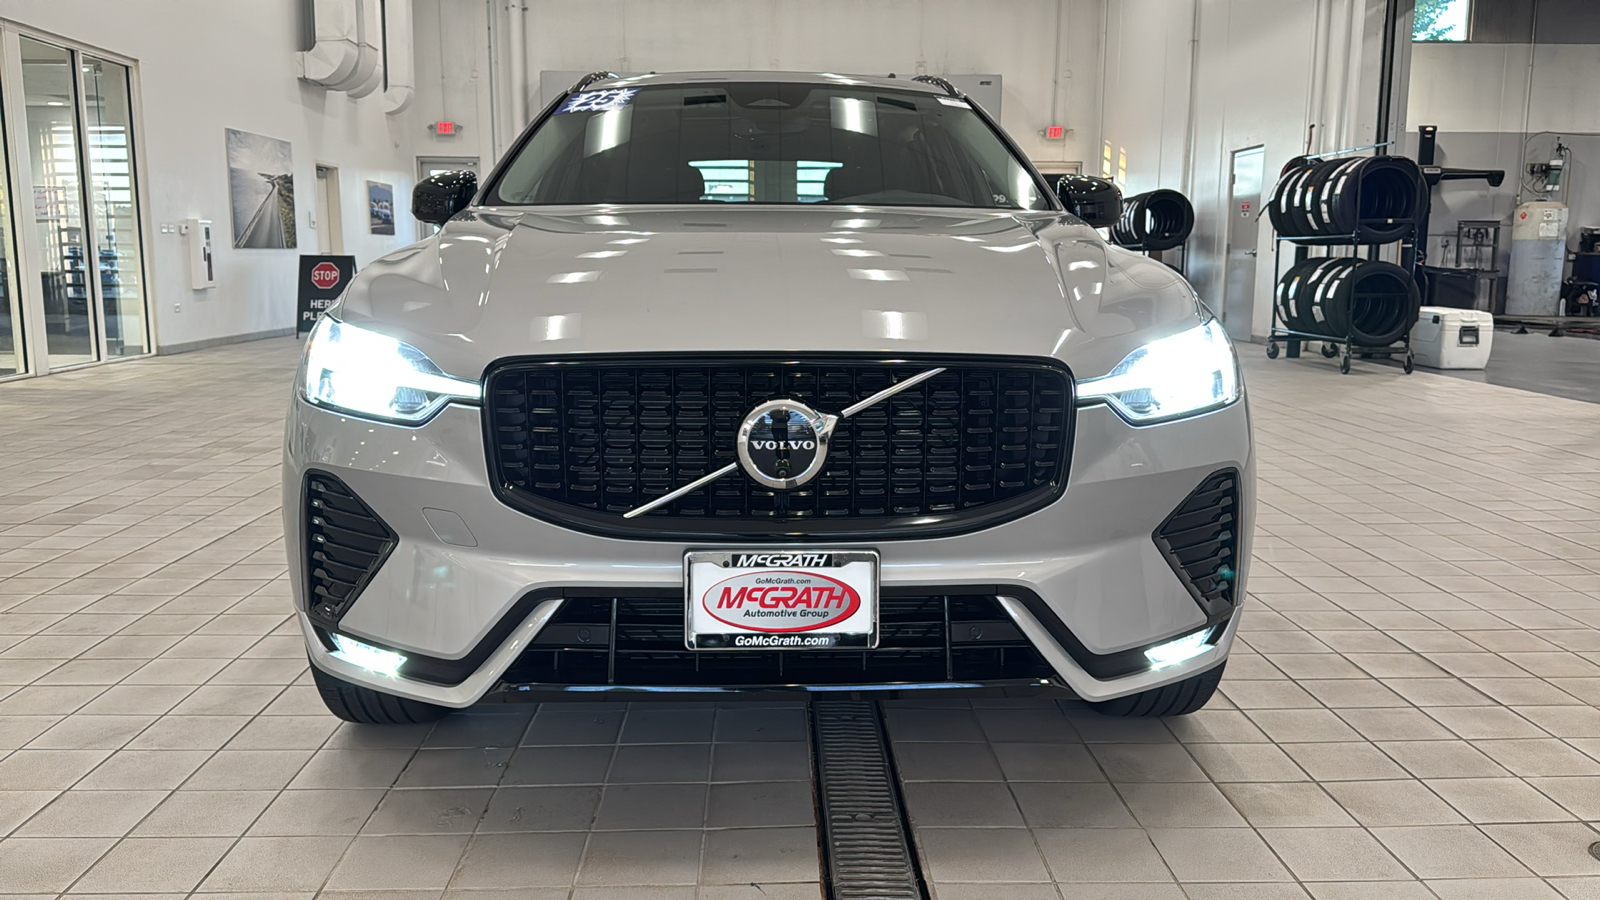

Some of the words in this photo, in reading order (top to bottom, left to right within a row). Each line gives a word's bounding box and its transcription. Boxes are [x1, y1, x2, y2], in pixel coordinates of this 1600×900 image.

[575, 92, 621, 107] 25
[438, 121, 453, 133] EXIT
[1048, 126, 1063, 138] EXIT
[313, 270, 338, 281] STOP
[310, 299, 334, 309] HER
[750, 440, 815, 450] VOLVO
[755, 577, 812, 585] GoMcGrath.com
[743, 608, 797, 618] Automotive
[799, 609, 829, 619] Group
[735, 635, 829, 647] GoMcGrath.com
